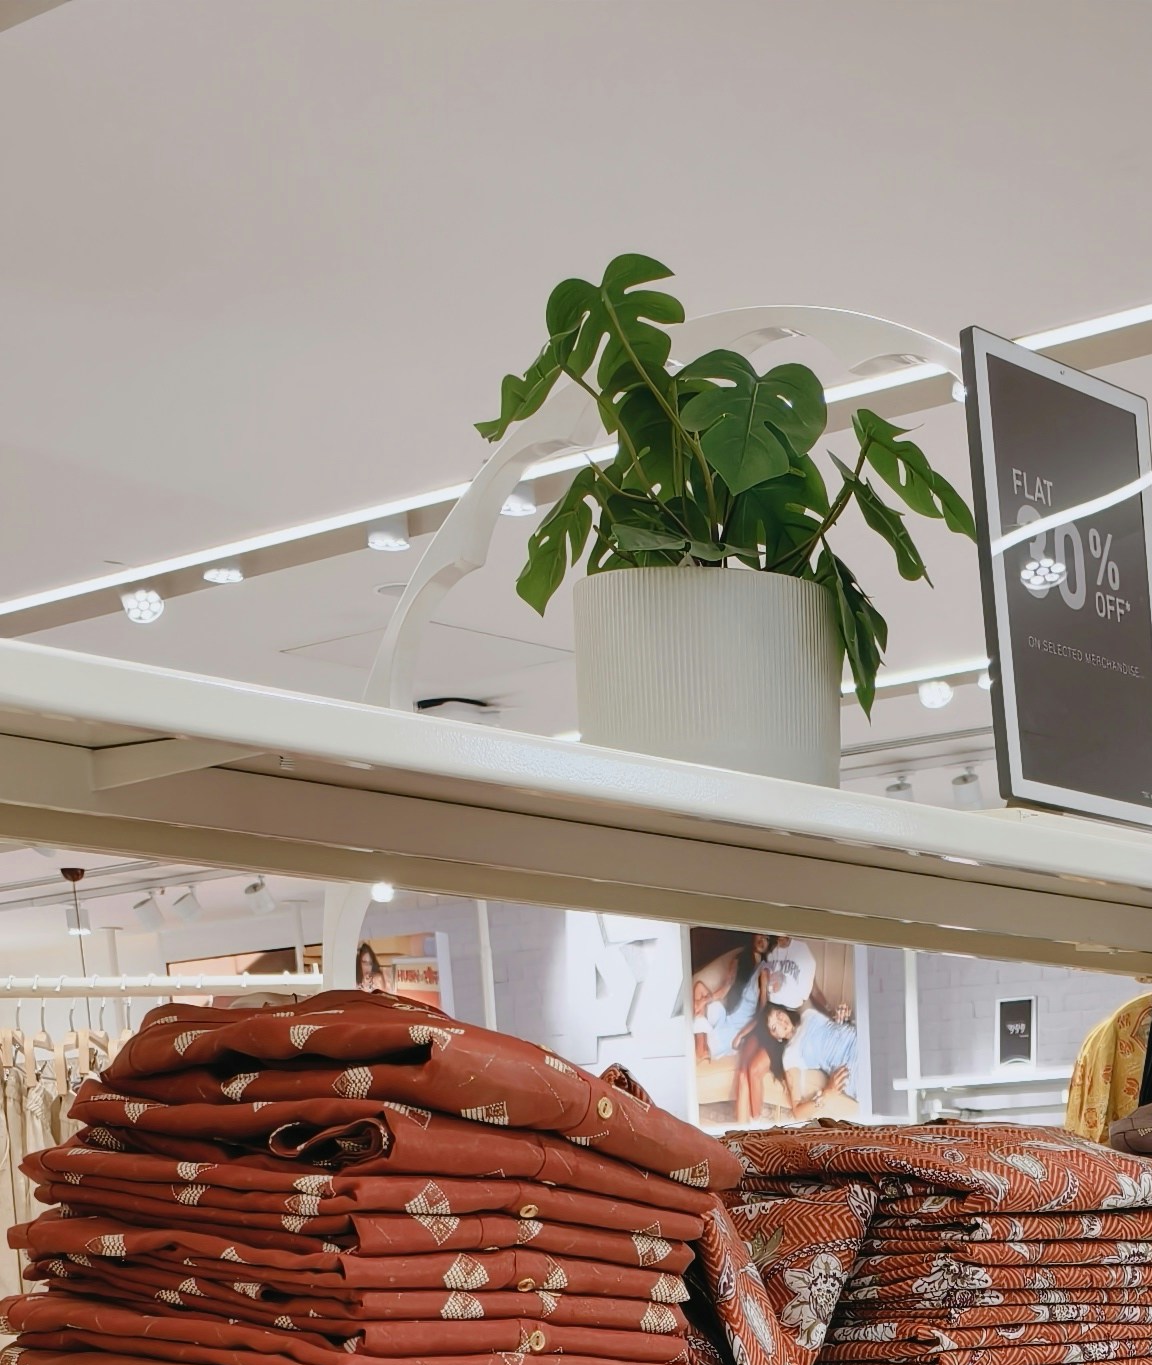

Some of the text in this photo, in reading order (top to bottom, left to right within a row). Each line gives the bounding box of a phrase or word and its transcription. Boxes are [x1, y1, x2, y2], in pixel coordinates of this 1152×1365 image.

[1012, 468, 1053, 507] FLAT
[1028, 635, 1041, 650] ON
[1043, 640, 1083, 662] SELECTED
